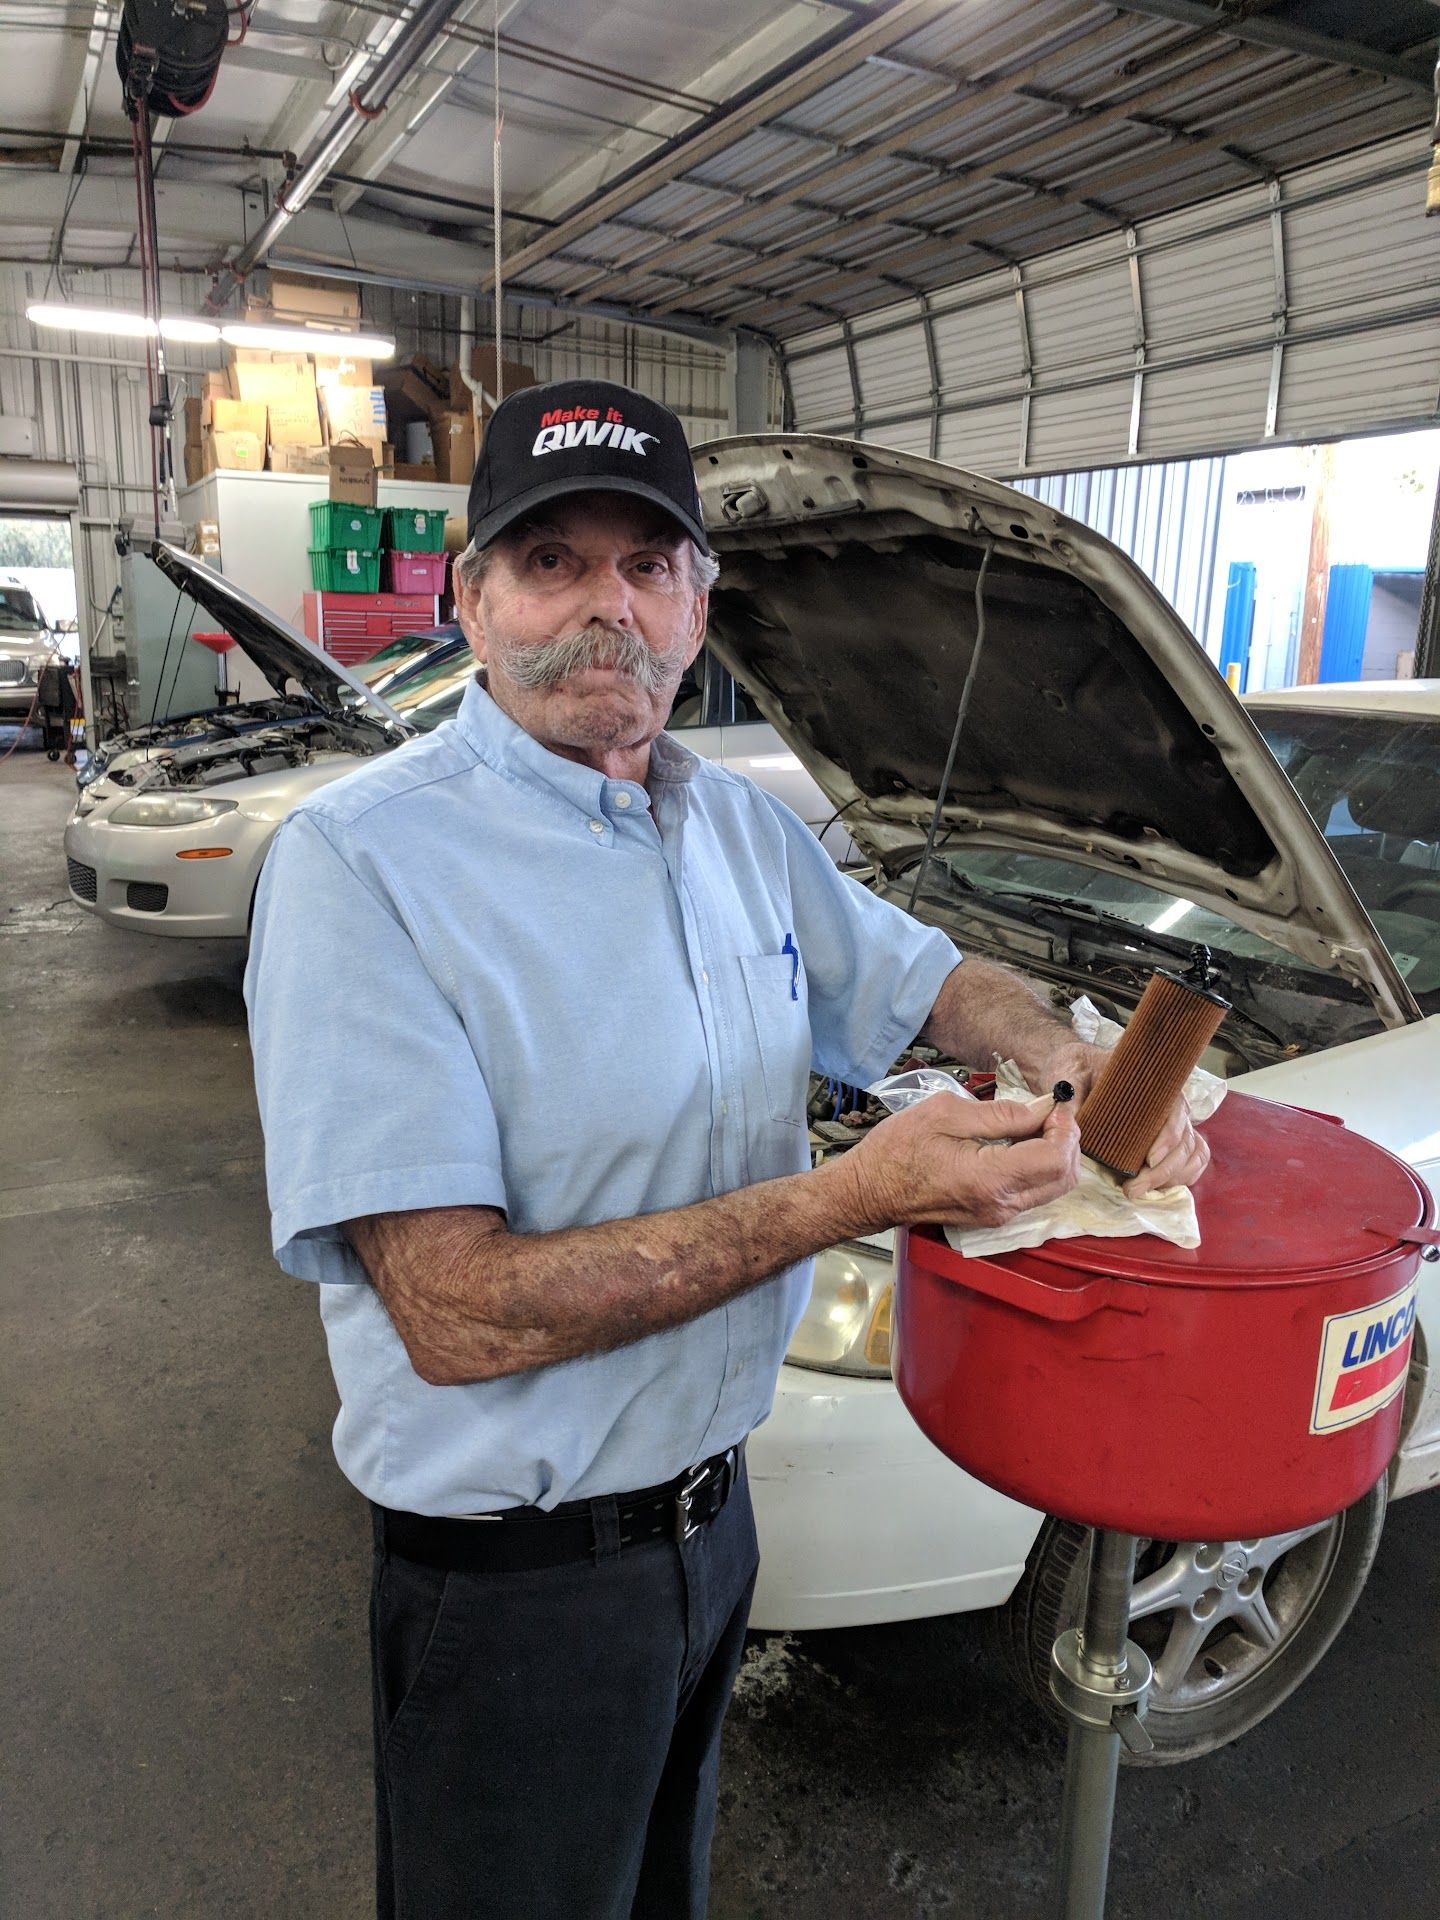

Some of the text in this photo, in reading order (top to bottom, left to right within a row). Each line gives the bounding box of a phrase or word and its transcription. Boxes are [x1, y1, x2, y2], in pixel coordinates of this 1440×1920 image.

[540, 405, 624, 428] Make it
[532, 420, 652, 457] QWIK
